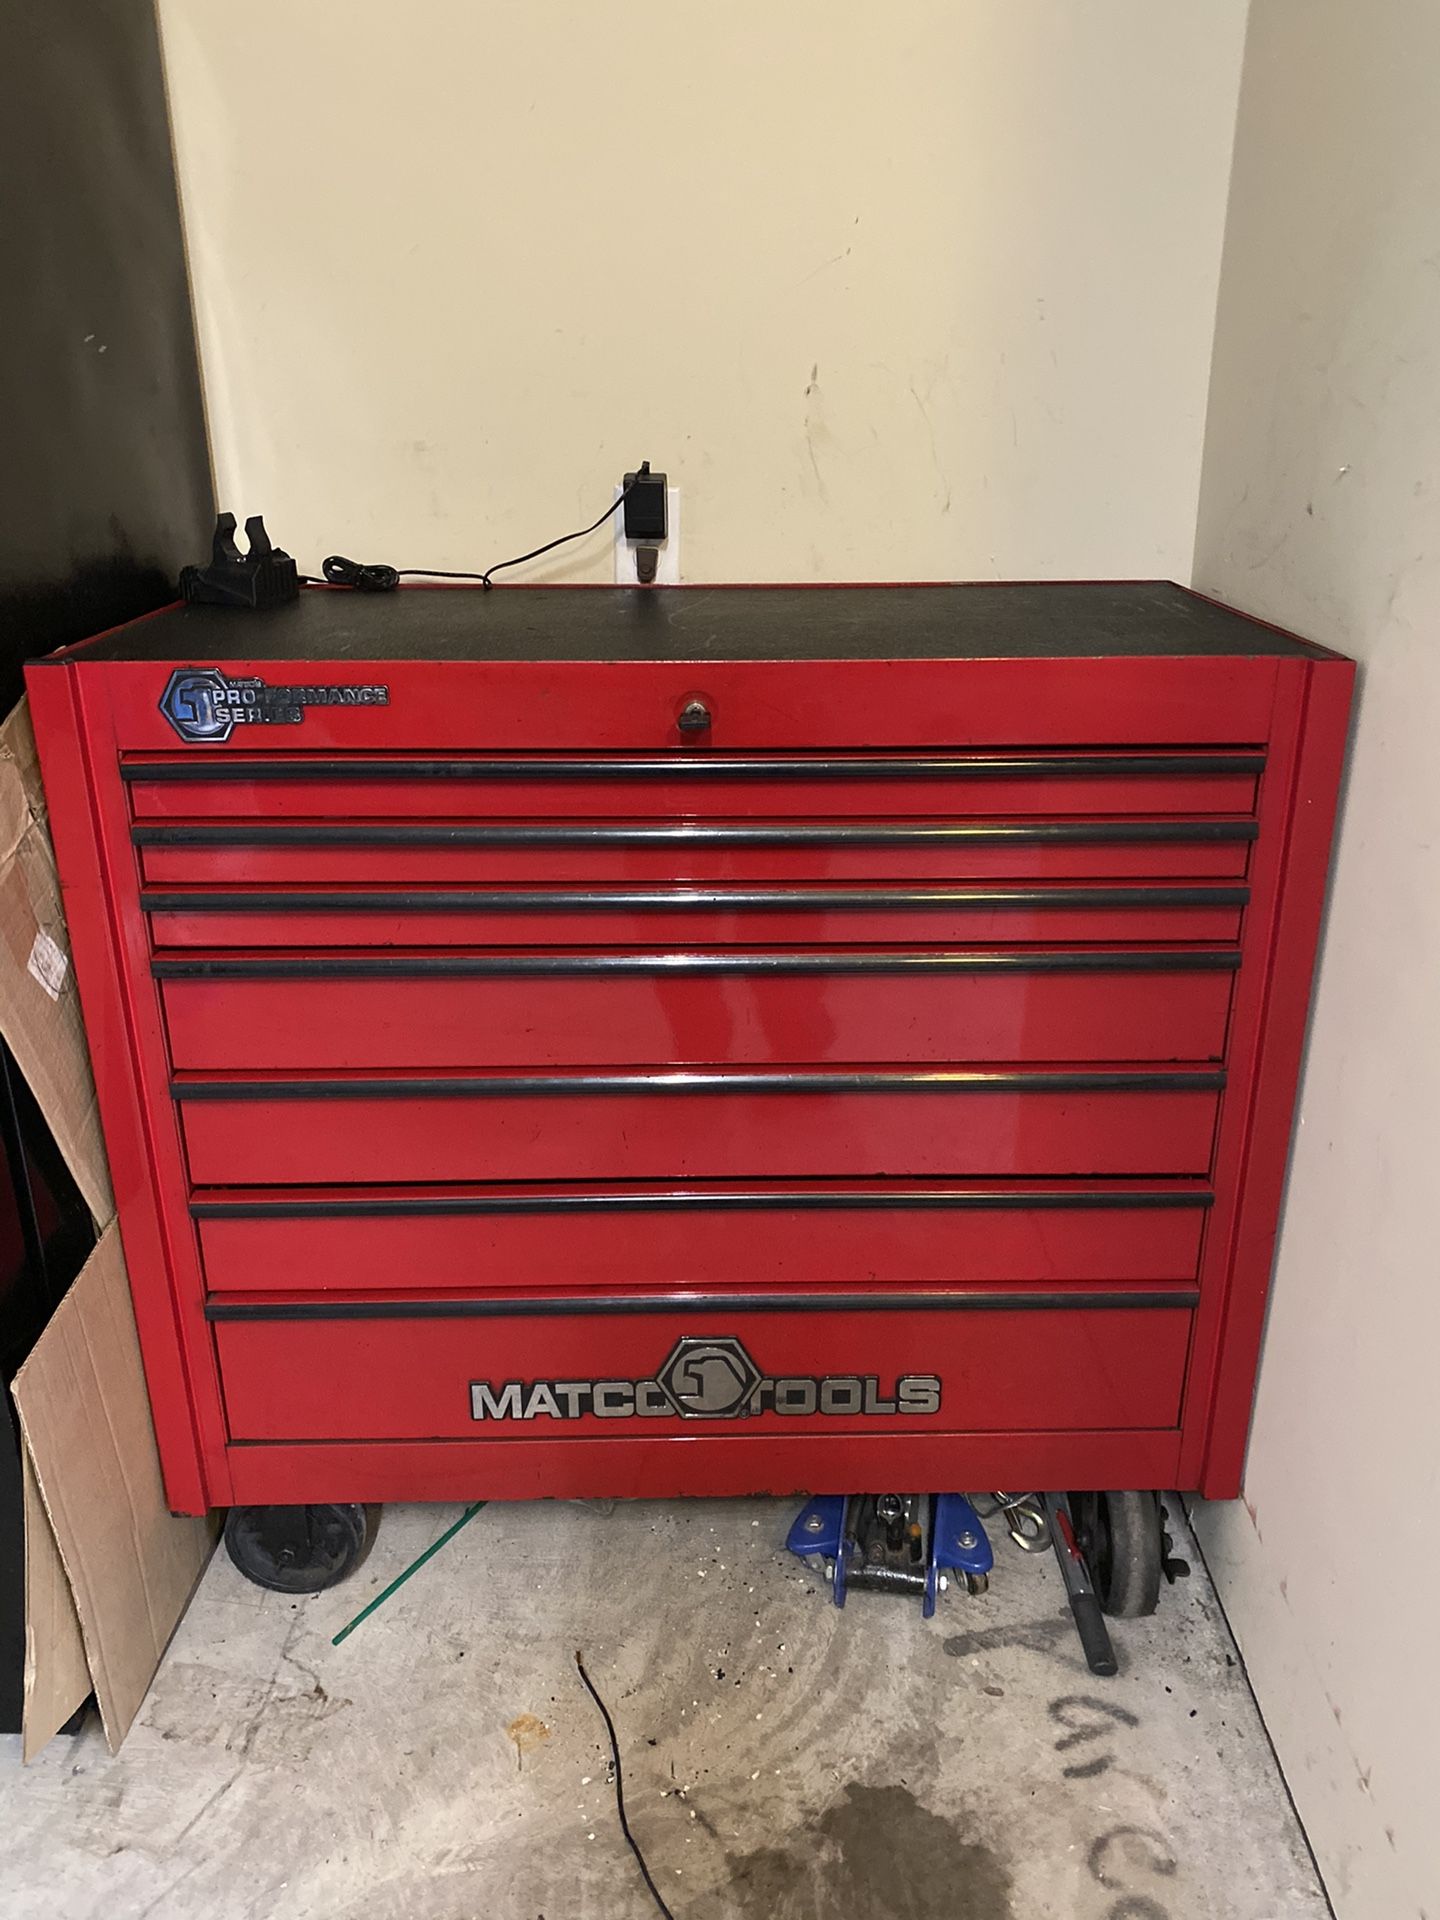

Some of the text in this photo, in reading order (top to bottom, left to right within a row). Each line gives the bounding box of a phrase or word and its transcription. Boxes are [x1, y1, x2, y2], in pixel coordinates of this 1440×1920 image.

[216, 707, 302, 723] SERIES
[471, 1379, 940, 1419] MATCO TOOLS
